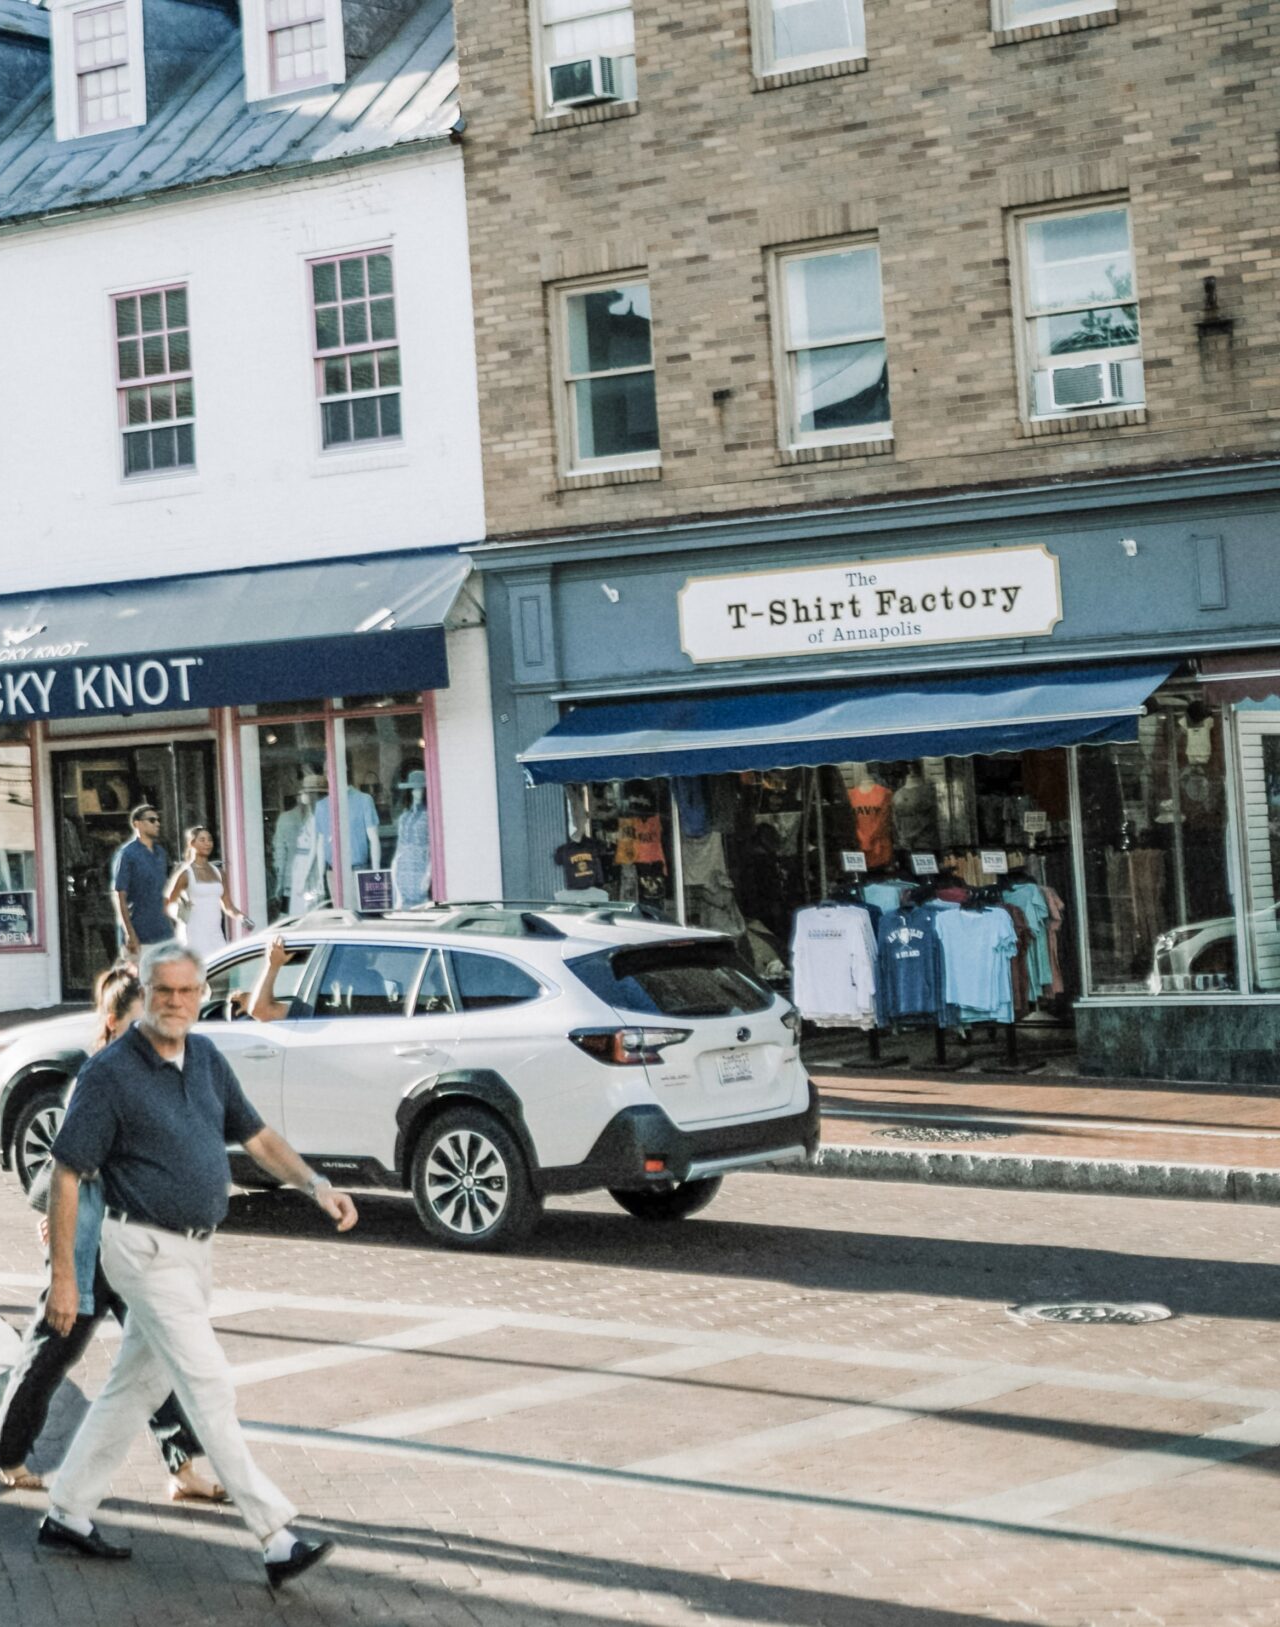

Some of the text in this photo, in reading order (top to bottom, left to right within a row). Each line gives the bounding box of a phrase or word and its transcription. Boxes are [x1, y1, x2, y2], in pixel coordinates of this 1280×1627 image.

[845, 572, 878, 588] The
[727, 586, 1023, 629] T-Shirt Factory
[807, 621, 922, 646] of Annapolis
[0, 932, 27, 943] OPEN
